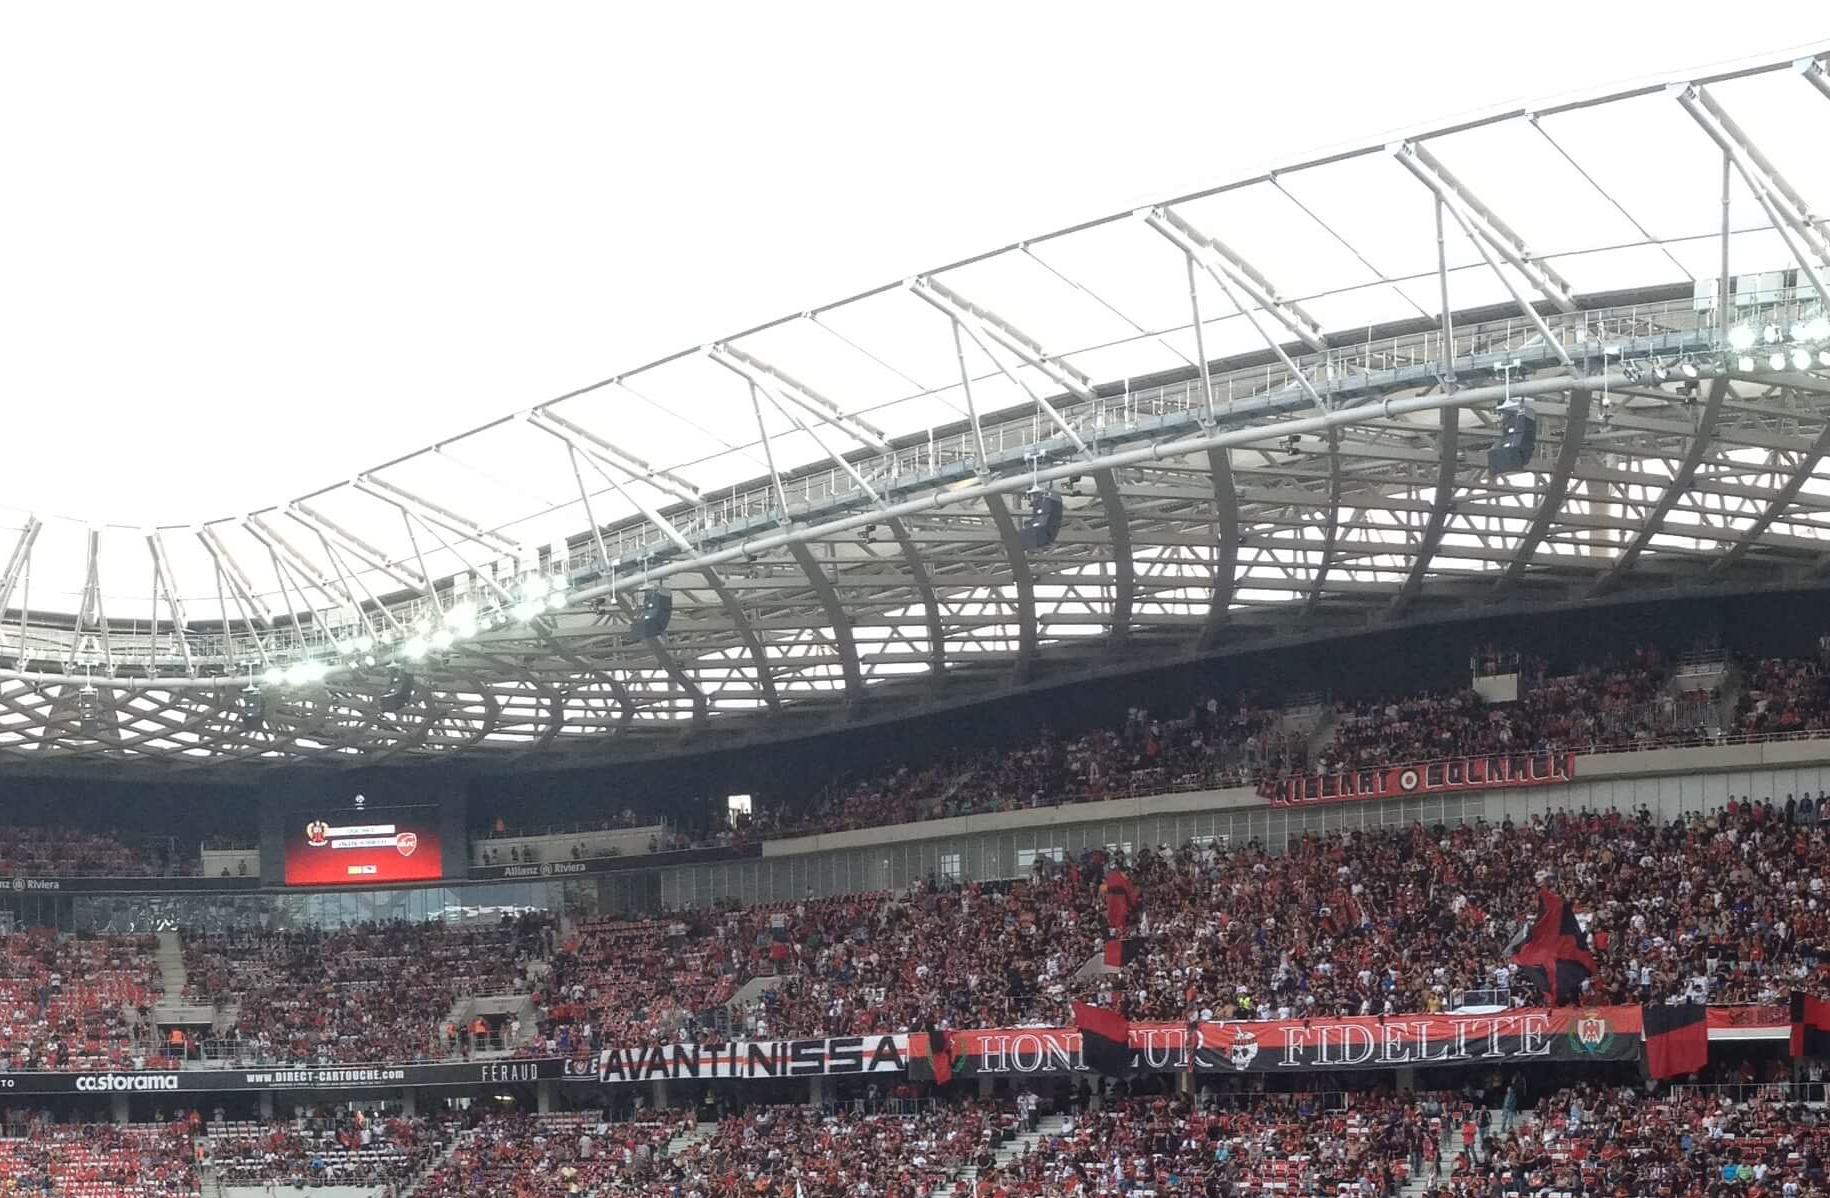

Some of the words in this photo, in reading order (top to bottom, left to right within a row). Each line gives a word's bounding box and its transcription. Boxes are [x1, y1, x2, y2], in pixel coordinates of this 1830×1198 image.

[505, 865, 539, 877] Allianz
[554, 862, 586, 873] Riviera
[27, 879, 60, 889] Riviera
[1277, 1013, 1552, 1067] FIDELITE
[603, 1042, 738, 1082] AVANTI
[746, 1035, 906, 1077] NISSA
[977, 1030, 1213, 1072] HONUR
[246, 1069, 404, 1083] www.DIRECT-CARTOUCHE.com
[481, 1062, 539, 1082] FÉRAUD
[76, 1074, 179, 1091] castorama
